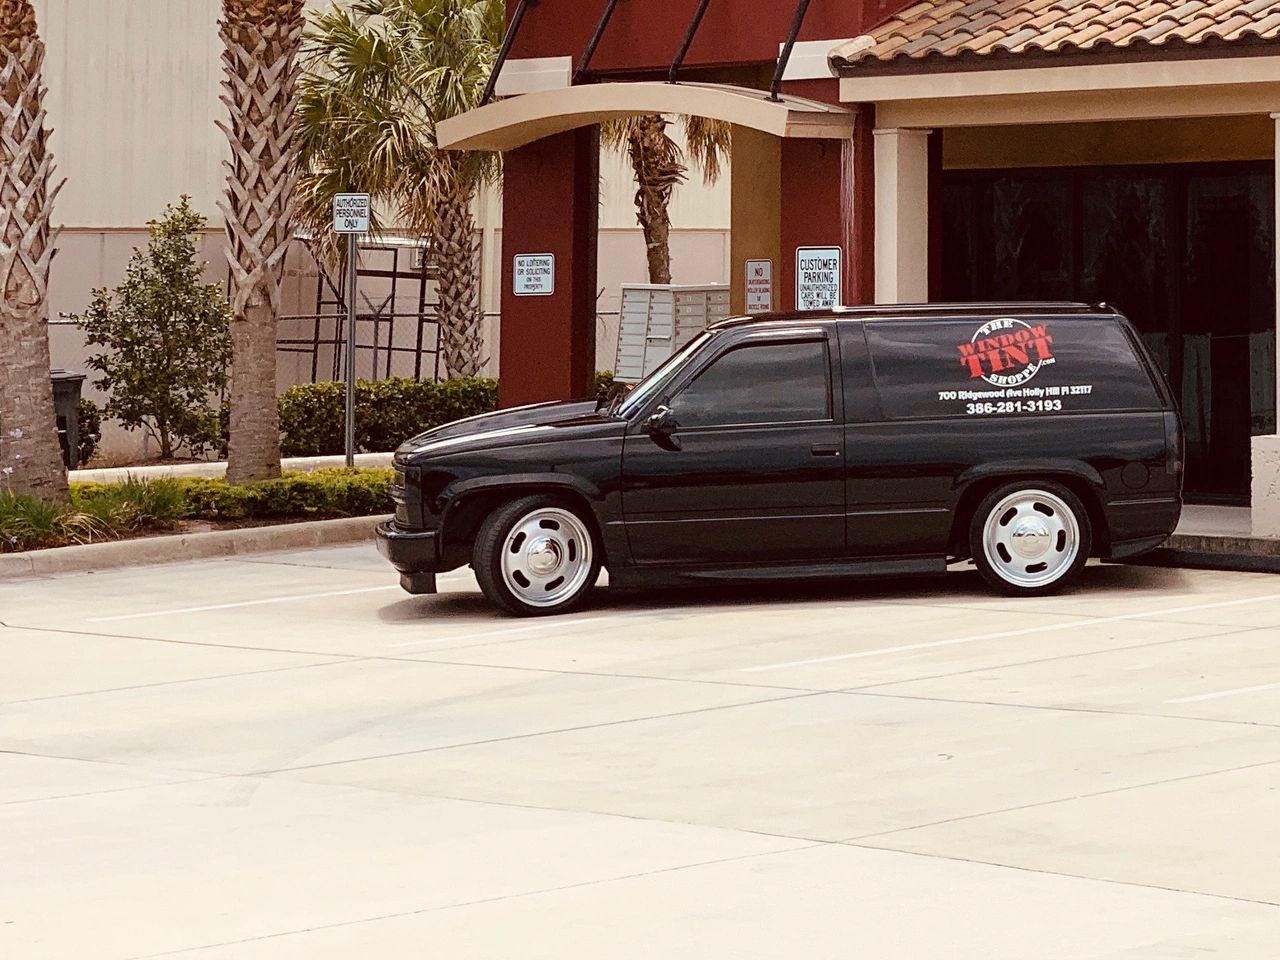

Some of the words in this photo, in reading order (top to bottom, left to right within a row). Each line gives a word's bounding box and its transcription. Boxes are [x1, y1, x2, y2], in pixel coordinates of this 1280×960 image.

[336, 198, 367, 208] AUTHORIZED
[336, 208, 367, 218] PERSONNEL
[344, 218, 358, 229] ONLY
[526, 259, 550, 267] LOITERING
[800, 258, 838, 271] CUSTOMER
[754, 267, 764, 277] NO
[803, 271, 834, 283] PARKING
[799, 283, 838, 292] UNAUTHORIZED
[801, 291, 815, 300] CARS
[816, 291, 828, 300] WILL
[829, 291, 837, 300] BE
[803, 299, 820, 308] TOWED
[821, 299, 835, 307] AWAY
[980, 320, 1014, 336] THE
[957, 324, 1048, 357] WINDOW
[960, 335, 1054, 378] TINT
[989, 363, 1037, 385] SHOPPE
[938, 391, 957, 400] 700
[958, 388, 1005, 401] Ridgewood
[1006, 388, 1022, 398] Ave
[1023, 387, 1045, 398] Holly
[1045, 386, 1060, 396] Hill
[1070, 385, 1093, 395] 32117
[966, 399, 1062, 415] 386-281-3193
